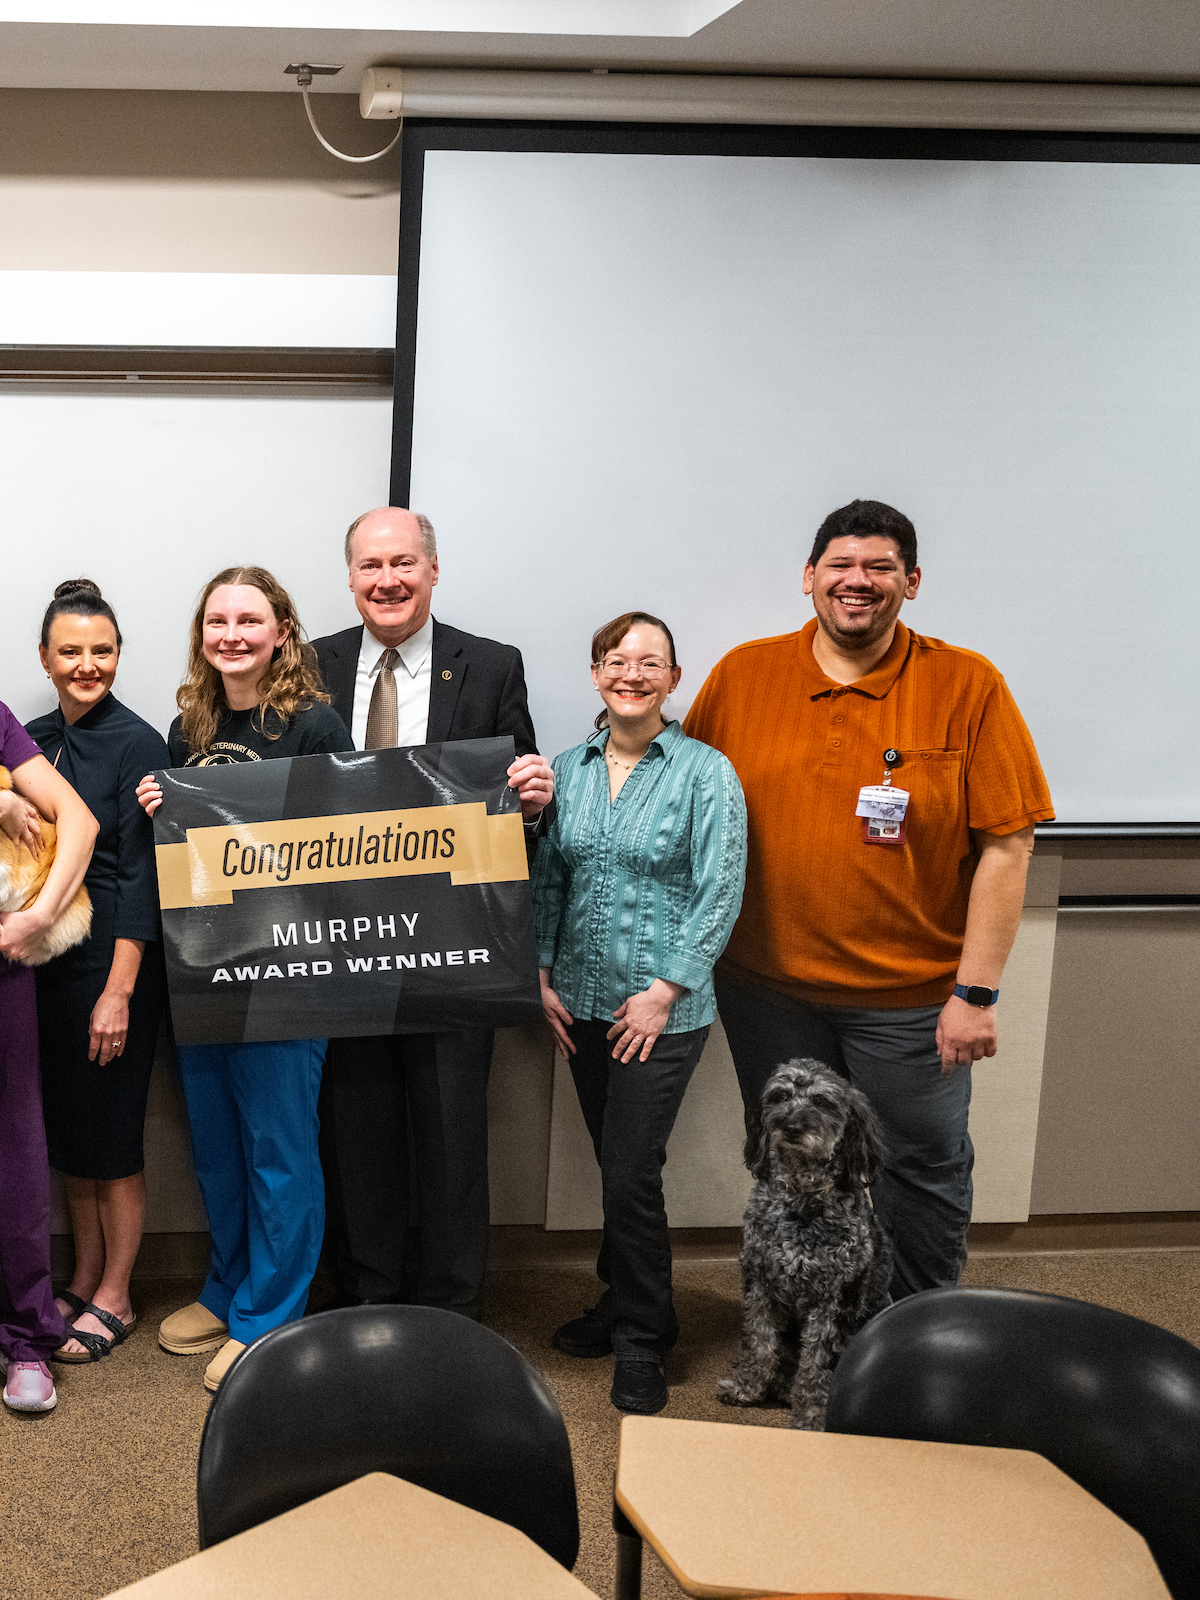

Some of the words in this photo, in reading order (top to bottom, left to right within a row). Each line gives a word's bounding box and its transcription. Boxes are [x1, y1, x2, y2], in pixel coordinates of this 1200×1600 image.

[183, 750, 208, 768] URDU
[222, 822, 456, 882] Congratulations
[272, 912, 420, 948] MURPHY
[211, 959, 333, 983] AWARD
[346, 948, 491, 974] WINNER
